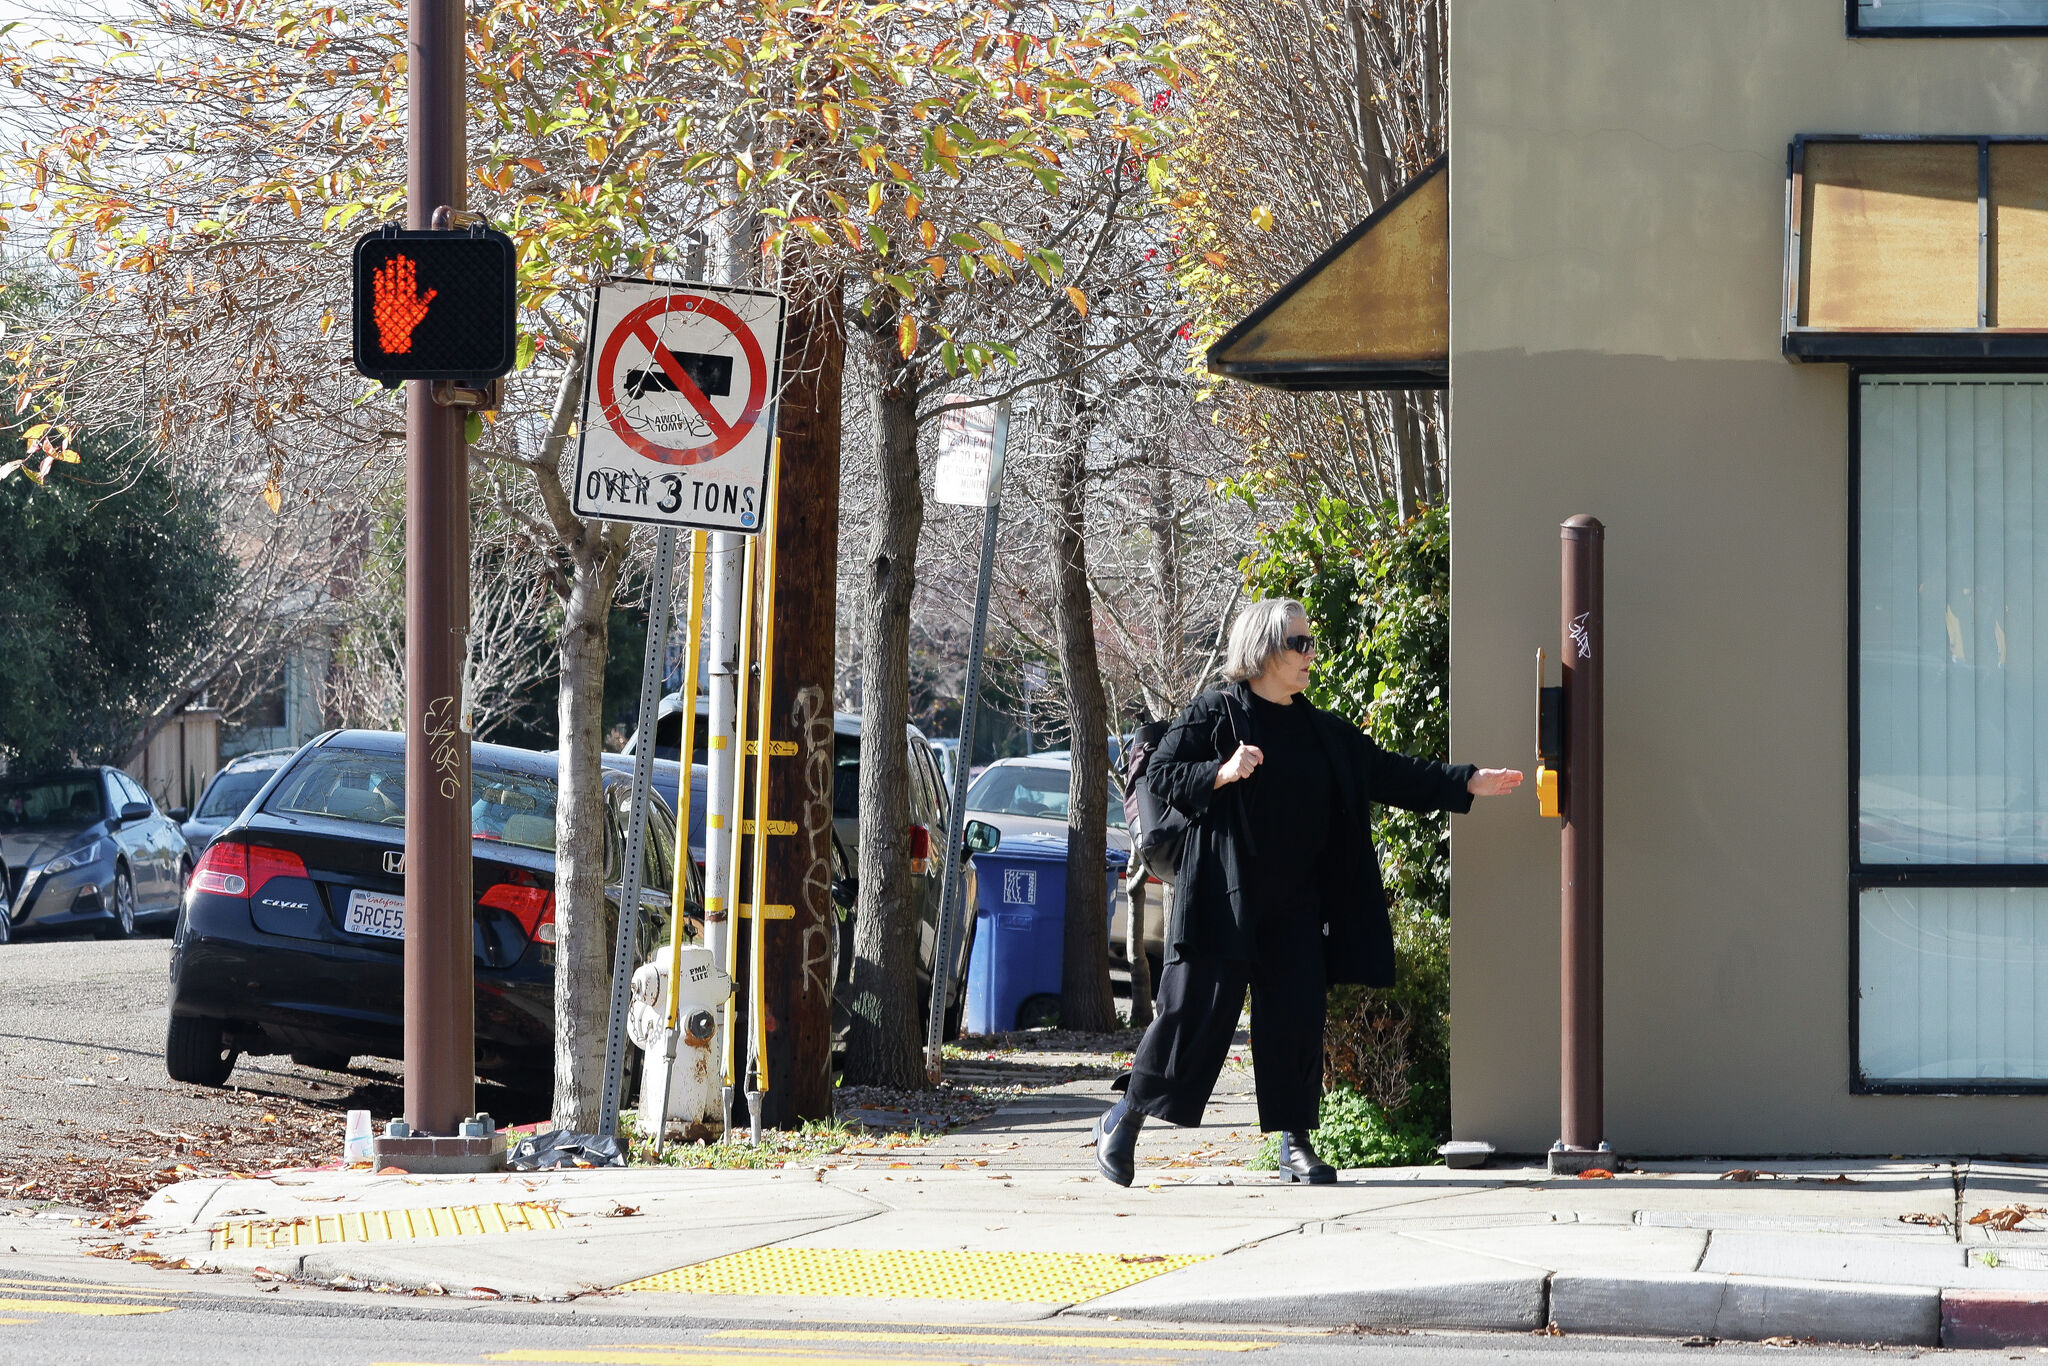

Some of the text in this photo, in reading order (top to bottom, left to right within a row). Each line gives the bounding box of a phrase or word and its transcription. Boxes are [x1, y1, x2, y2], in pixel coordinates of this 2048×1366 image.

[655, 414, 683, 424] AWOL
[586, 470, 650, 505] OVER
[656, 475, 682, 513] 3
[692, 481, 755, 514] TONS
[262, 898, 308, 910] CIVIC
[368, 897, 404, 907] Californ
[353, 904, 405, 930] 5RCE5
[690, 965, 706, 975] PMA
[691, 971, 708, 982] LIFE
